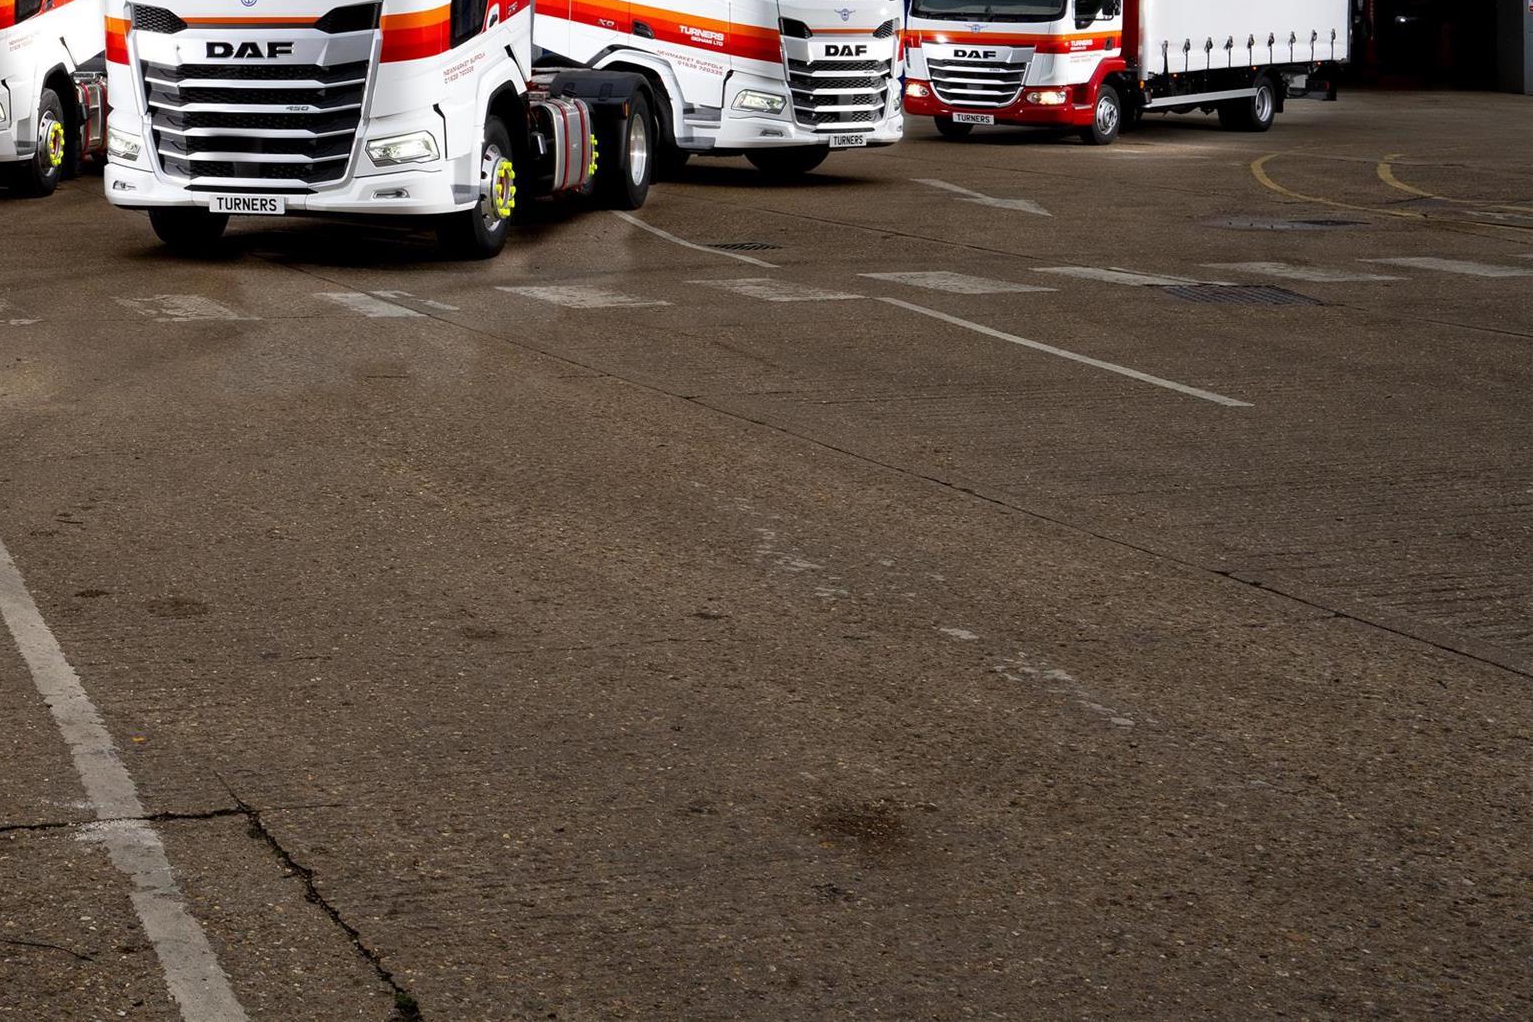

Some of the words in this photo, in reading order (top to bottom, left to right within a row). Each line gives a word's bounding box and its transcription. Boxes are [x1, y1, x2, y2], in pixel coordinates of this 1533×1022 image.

[679, 24, 725, 41] TURNERS
[206, 41, 295, 59] DAF
[824, 44, 867, 57] DAF
[953, 49, 997, 59] DAF
[956, 113, 991, 124] TURNERS
[833, 134, 864, 146] TURNERS
[216, 197, 277, 212] TURNERS
